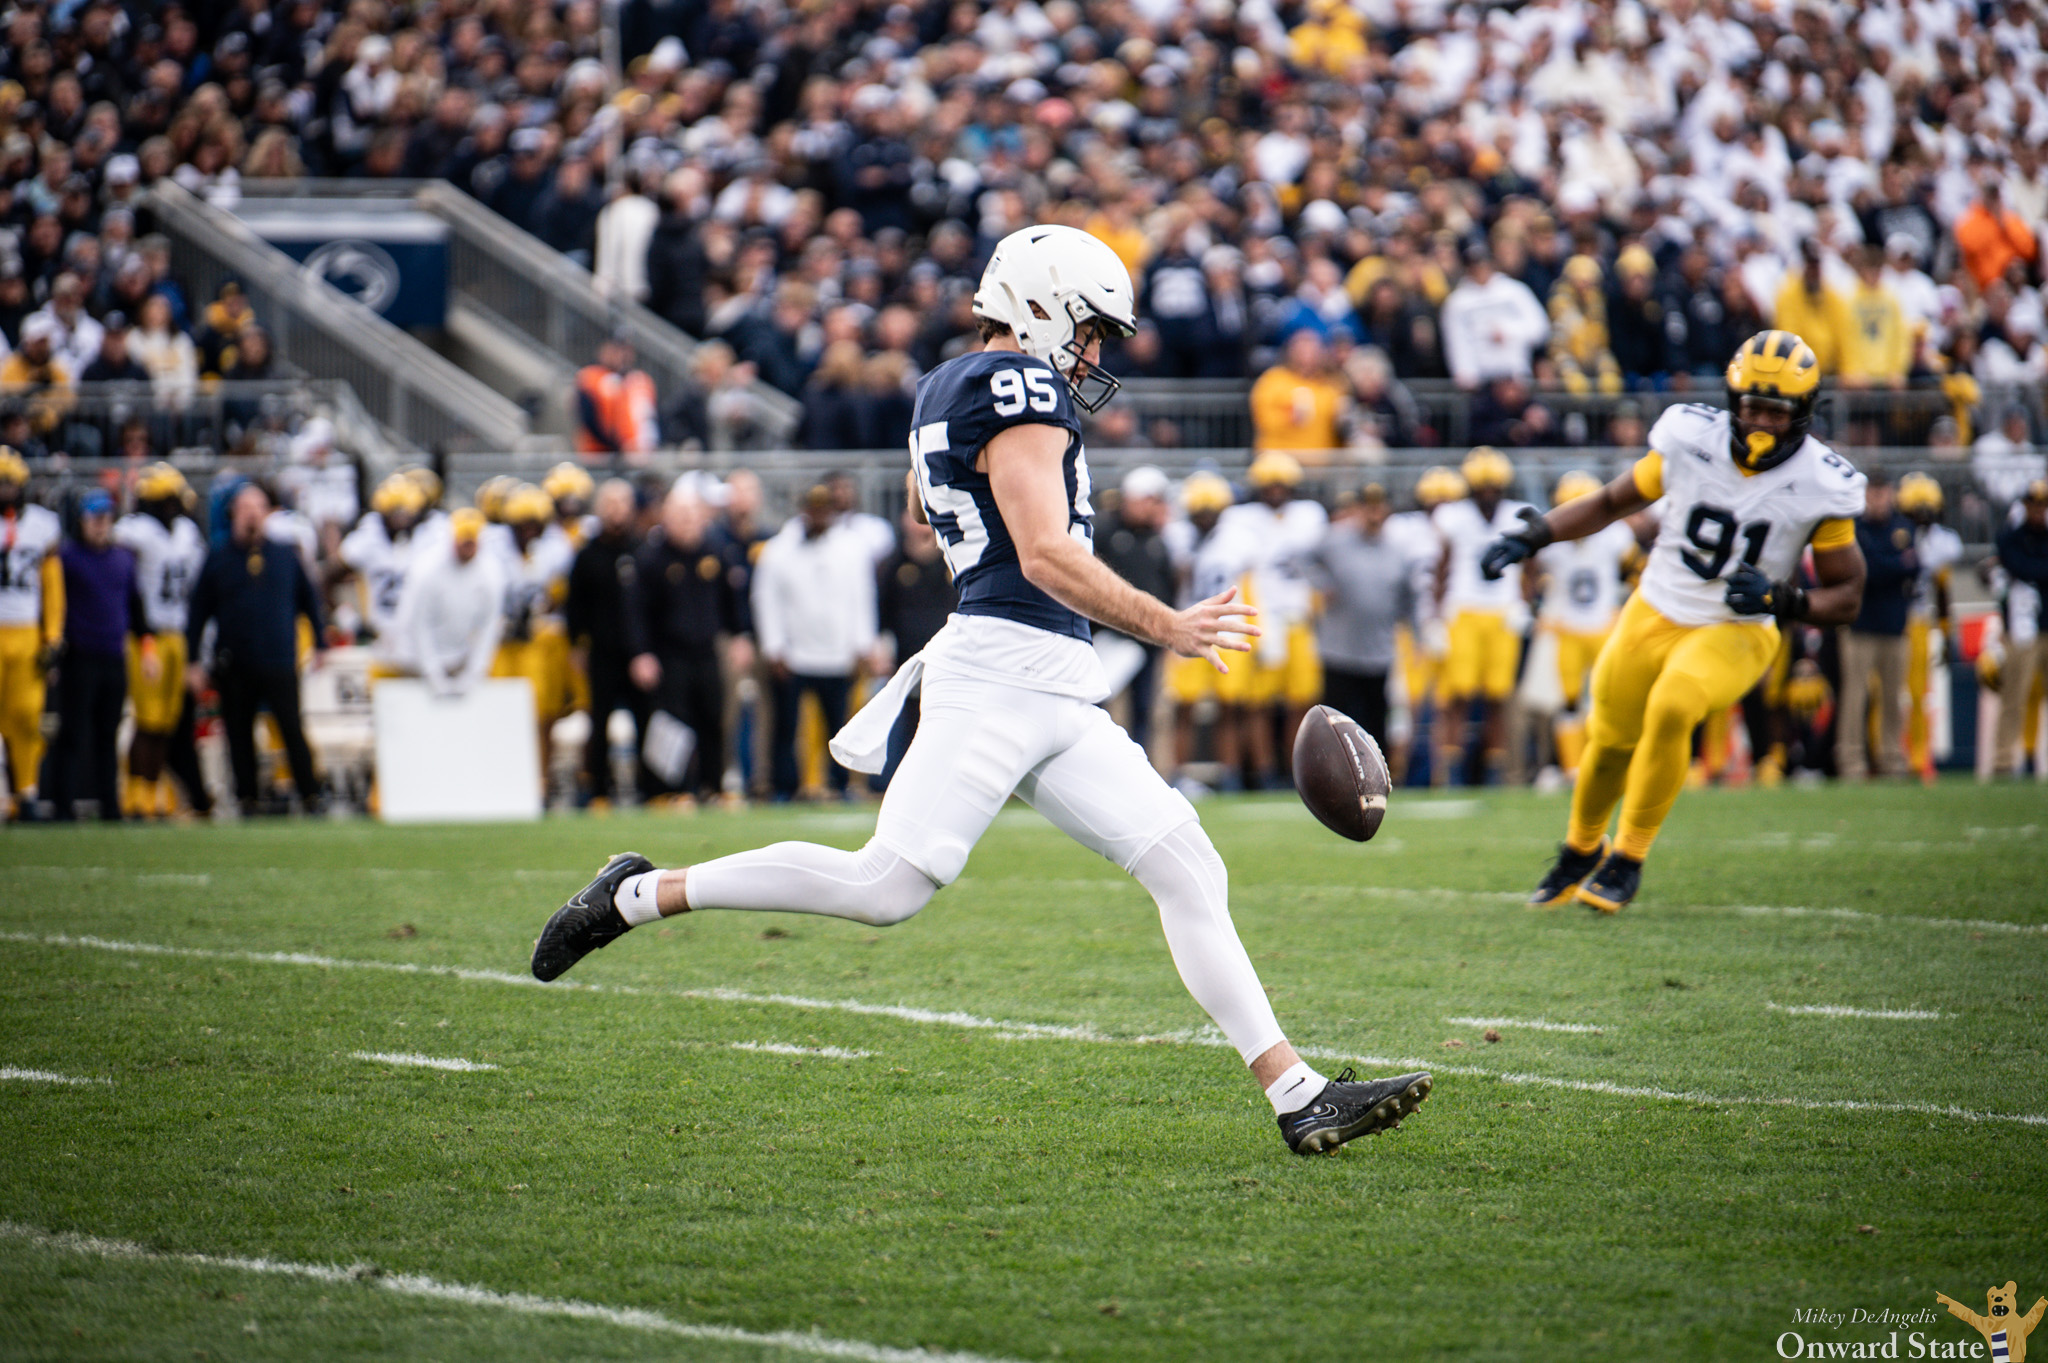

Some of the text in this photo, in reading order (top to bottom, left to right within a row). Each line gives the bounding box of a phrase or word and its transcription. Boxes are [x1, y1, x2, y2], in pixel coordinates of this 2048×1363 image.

[990, 367, 1058, 418] 95
[908, 420, 990, 579] 5
[1680, 502, 1770, 580] 91
